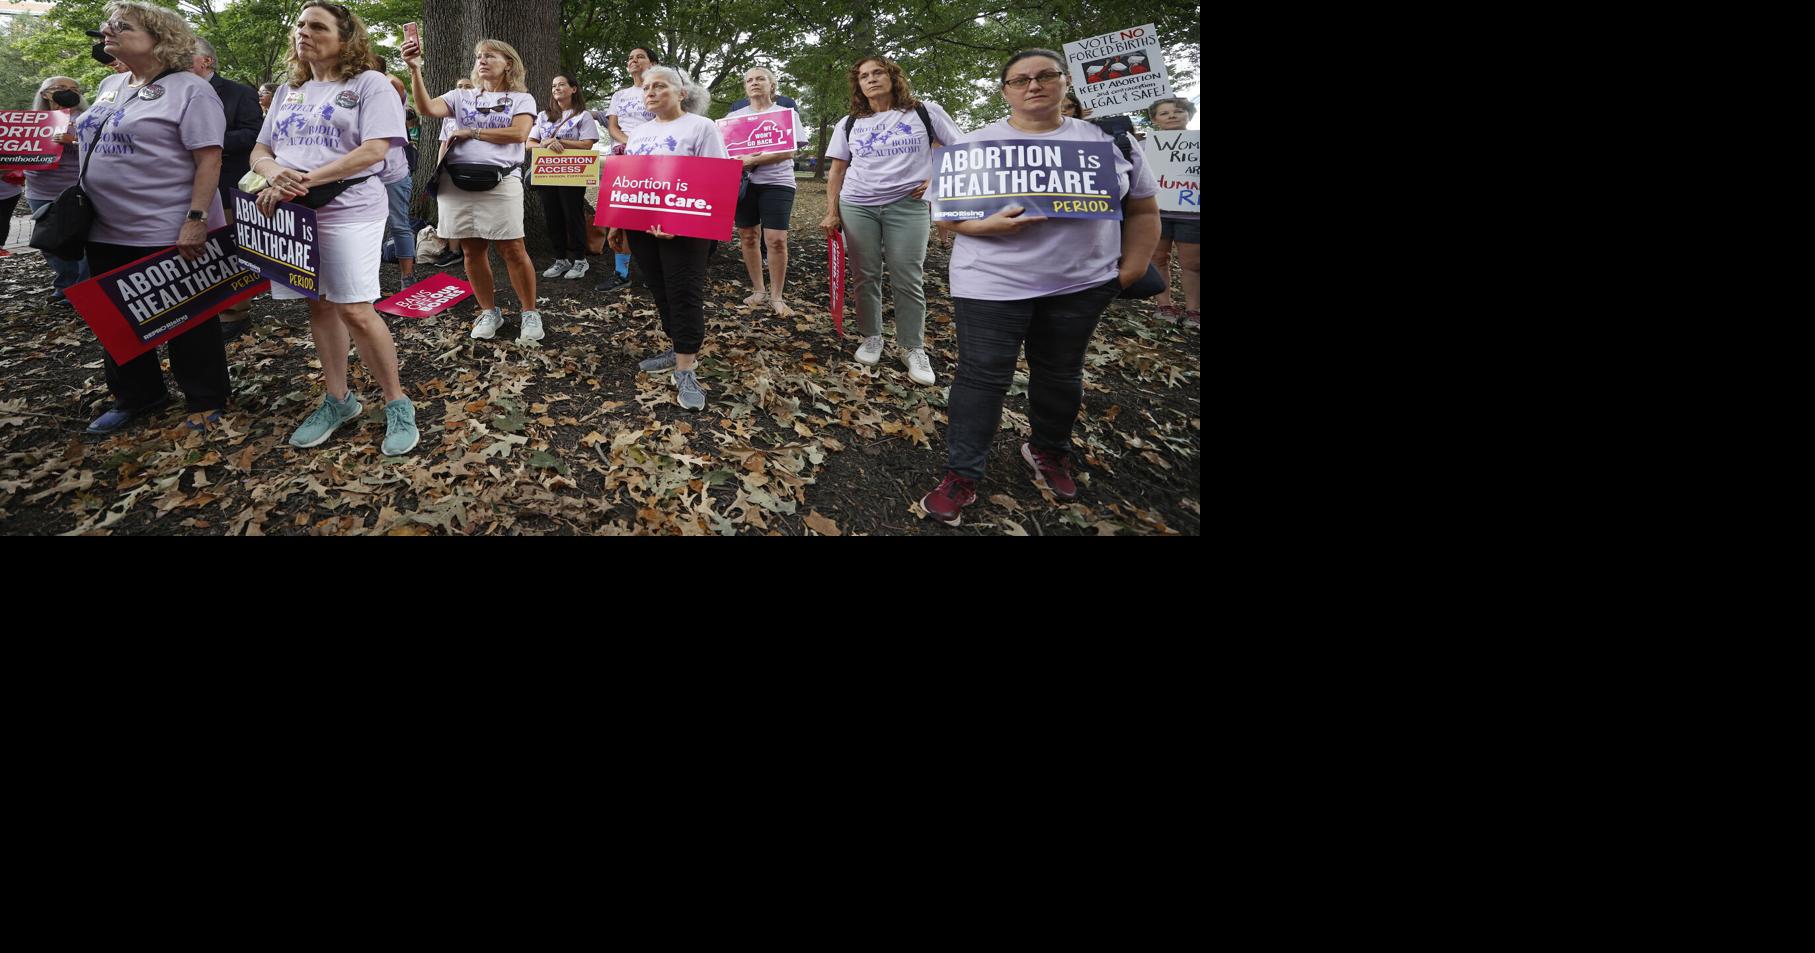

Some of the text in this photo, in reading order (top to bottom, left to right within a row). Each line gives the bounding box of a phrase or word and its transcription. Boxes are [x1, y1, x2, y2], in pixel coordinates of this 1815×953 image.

[1069, 35, 1157, 63] FORCED BIRTHS
[1078, 28, 1145, 50] VOTE NO
[1079, 72, 1161, 94] KEEP ABORTION
[1083, 95, 1121, 109] LEGAL
[1131, 84, 1166, 101] SAFE!
[0, 112, 49, 123] KEEP
[757, 138, 773, 146] BACK
[940, 146, 1101, 174] ABORTION is
[612, 176, 688, 192] Abortion is
[938, 170, 1108, 198] HEALTHCARE.
[610, 190, 712, 210] Health Care.
[1053, 200, 1115, 214] PERIOD.
[302, 217, 314, 242] is
[236, 222, 315, 272] HEALTHCARE.
[289, 273, 316, 291] PERIOD.
[430, 285, 461, 299] OUR
[395, 289, 432, 307] BANS
